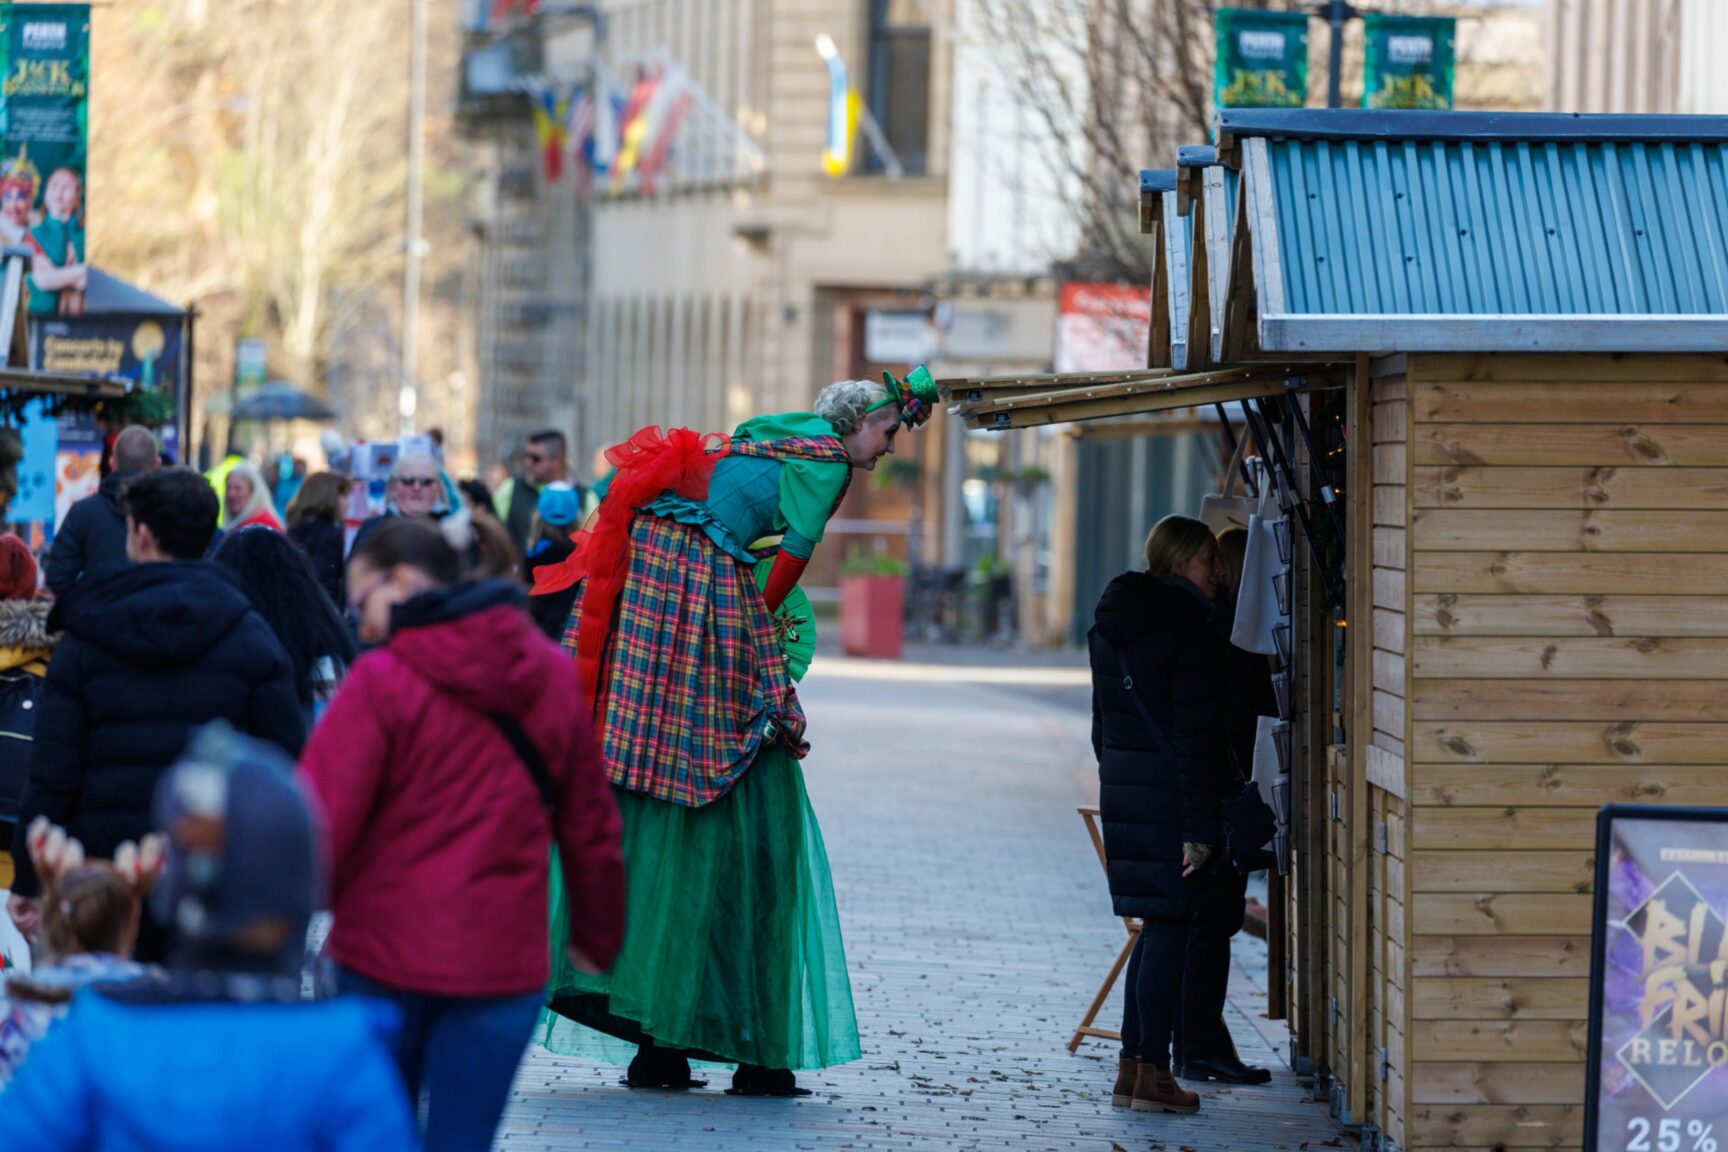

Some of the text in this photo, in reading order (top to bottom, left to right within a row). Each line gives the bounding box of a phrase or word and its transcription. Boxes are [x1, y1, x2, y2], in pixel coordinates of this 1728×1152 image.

[1641, 899, 1728, 976] BL
[1629, 1039, 1728, 1067] RELO
[1626, 1117, 1718, 1152] 25%
